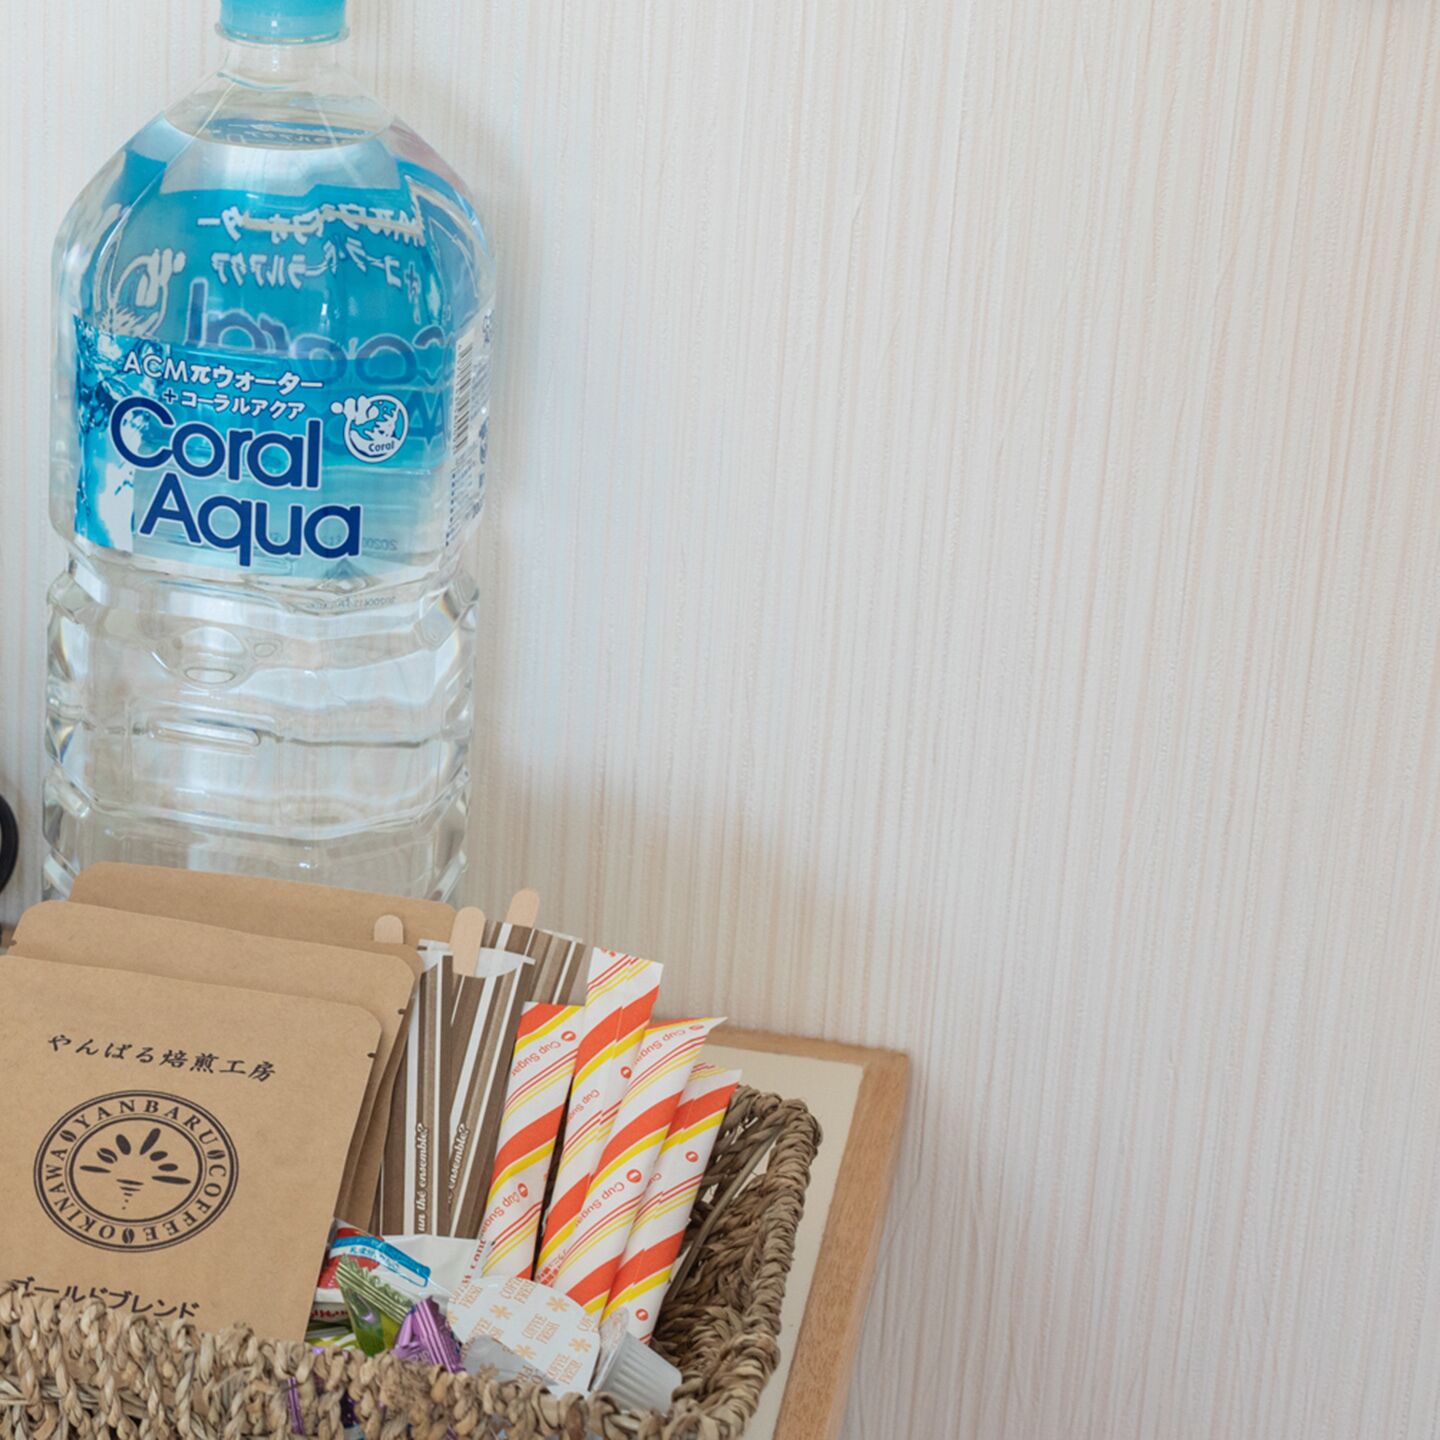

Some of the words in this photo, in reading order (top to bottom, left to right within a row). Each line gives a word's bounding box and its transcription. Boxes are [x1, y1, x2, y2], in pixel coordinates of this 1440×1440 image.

[110, 396, 322, 489] Coral
[367, 439, 395, 453] Coral
[138, 472, 361, 567] Aqua
[47, 1034, 276, 1083] やんばる焙煎工房
[73, 1098, 218, 1146] YANBARU
[46, 1147, 116, 1242] OKINAWA
[144, 1163, 228, 1243] COFFEE
